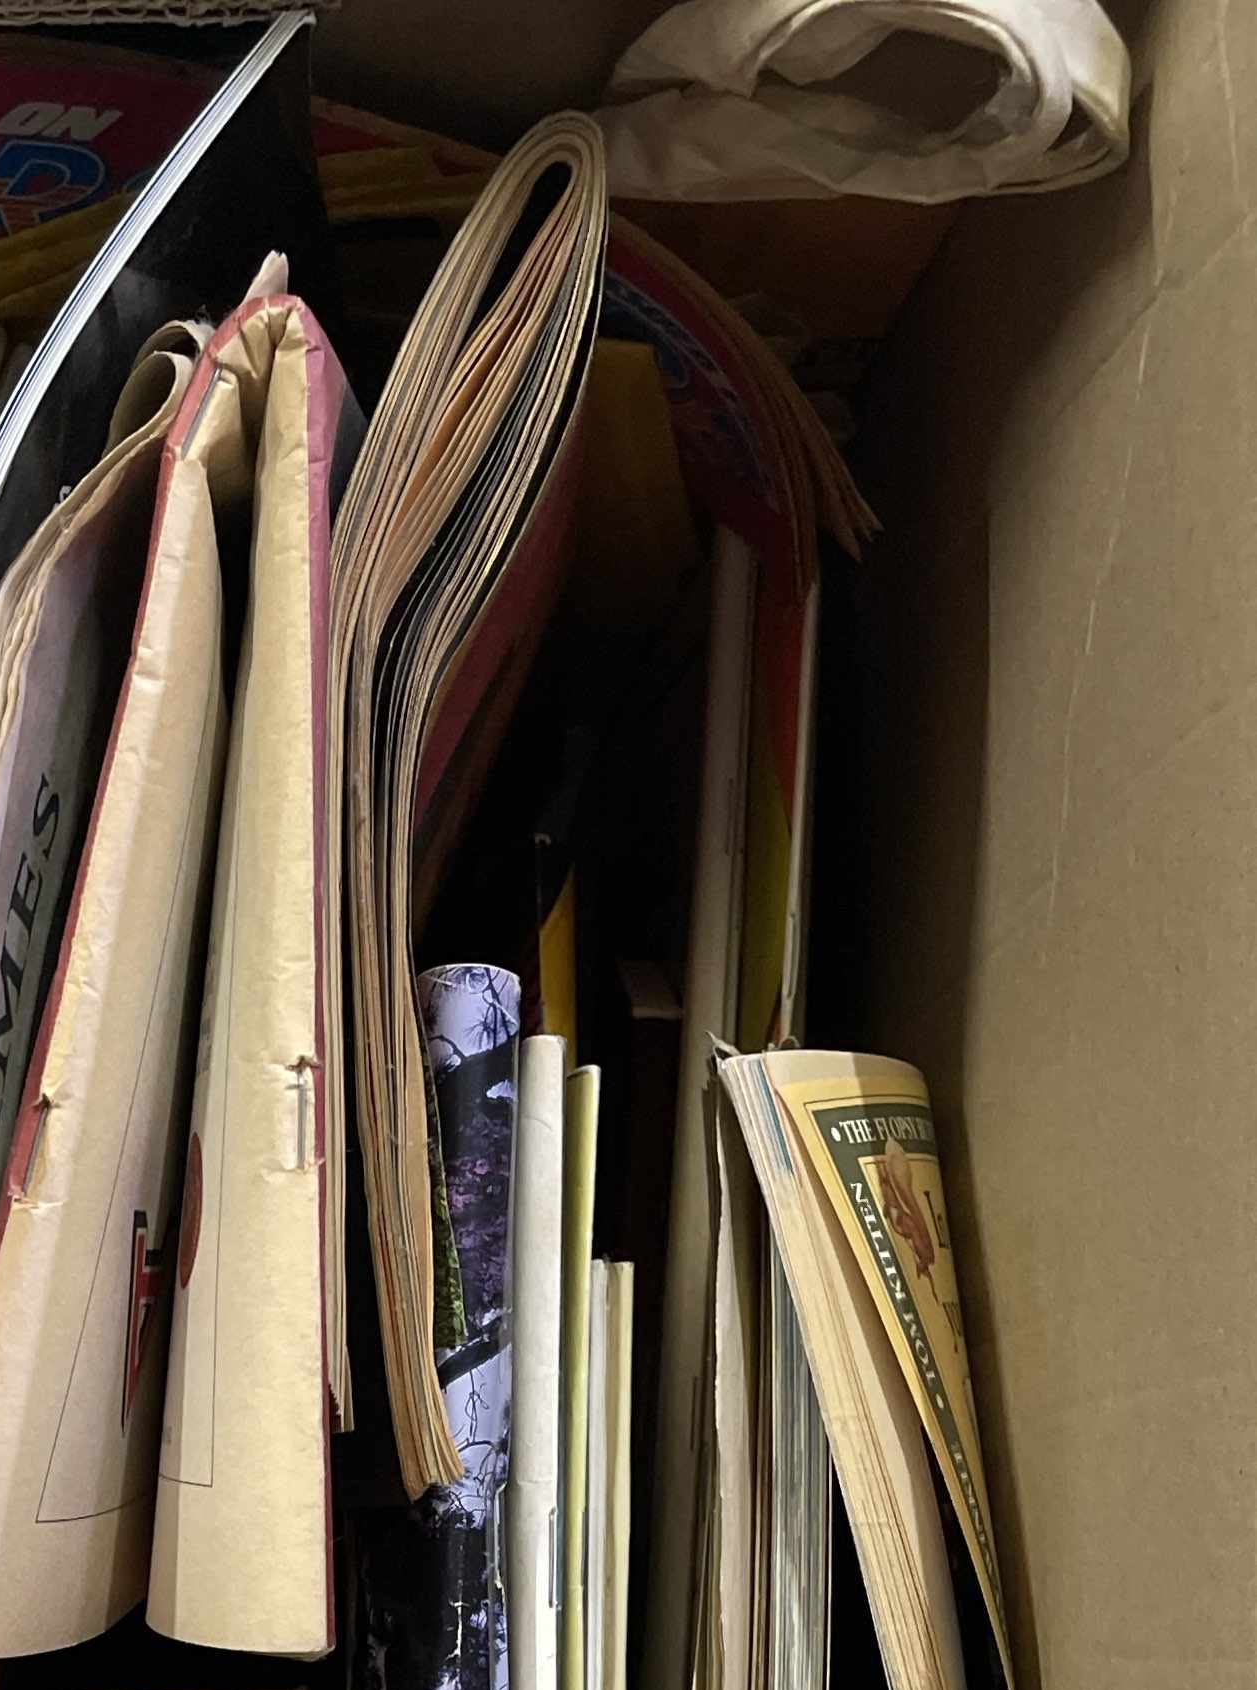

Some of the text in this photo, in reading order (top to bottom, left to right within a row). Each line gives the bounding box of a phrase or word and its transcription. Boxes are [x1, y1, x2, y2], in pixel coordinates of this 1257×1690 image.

[839, 1118, 875, 1144] THE
[849, 1182, 936, 1386] TOM KITTEN
